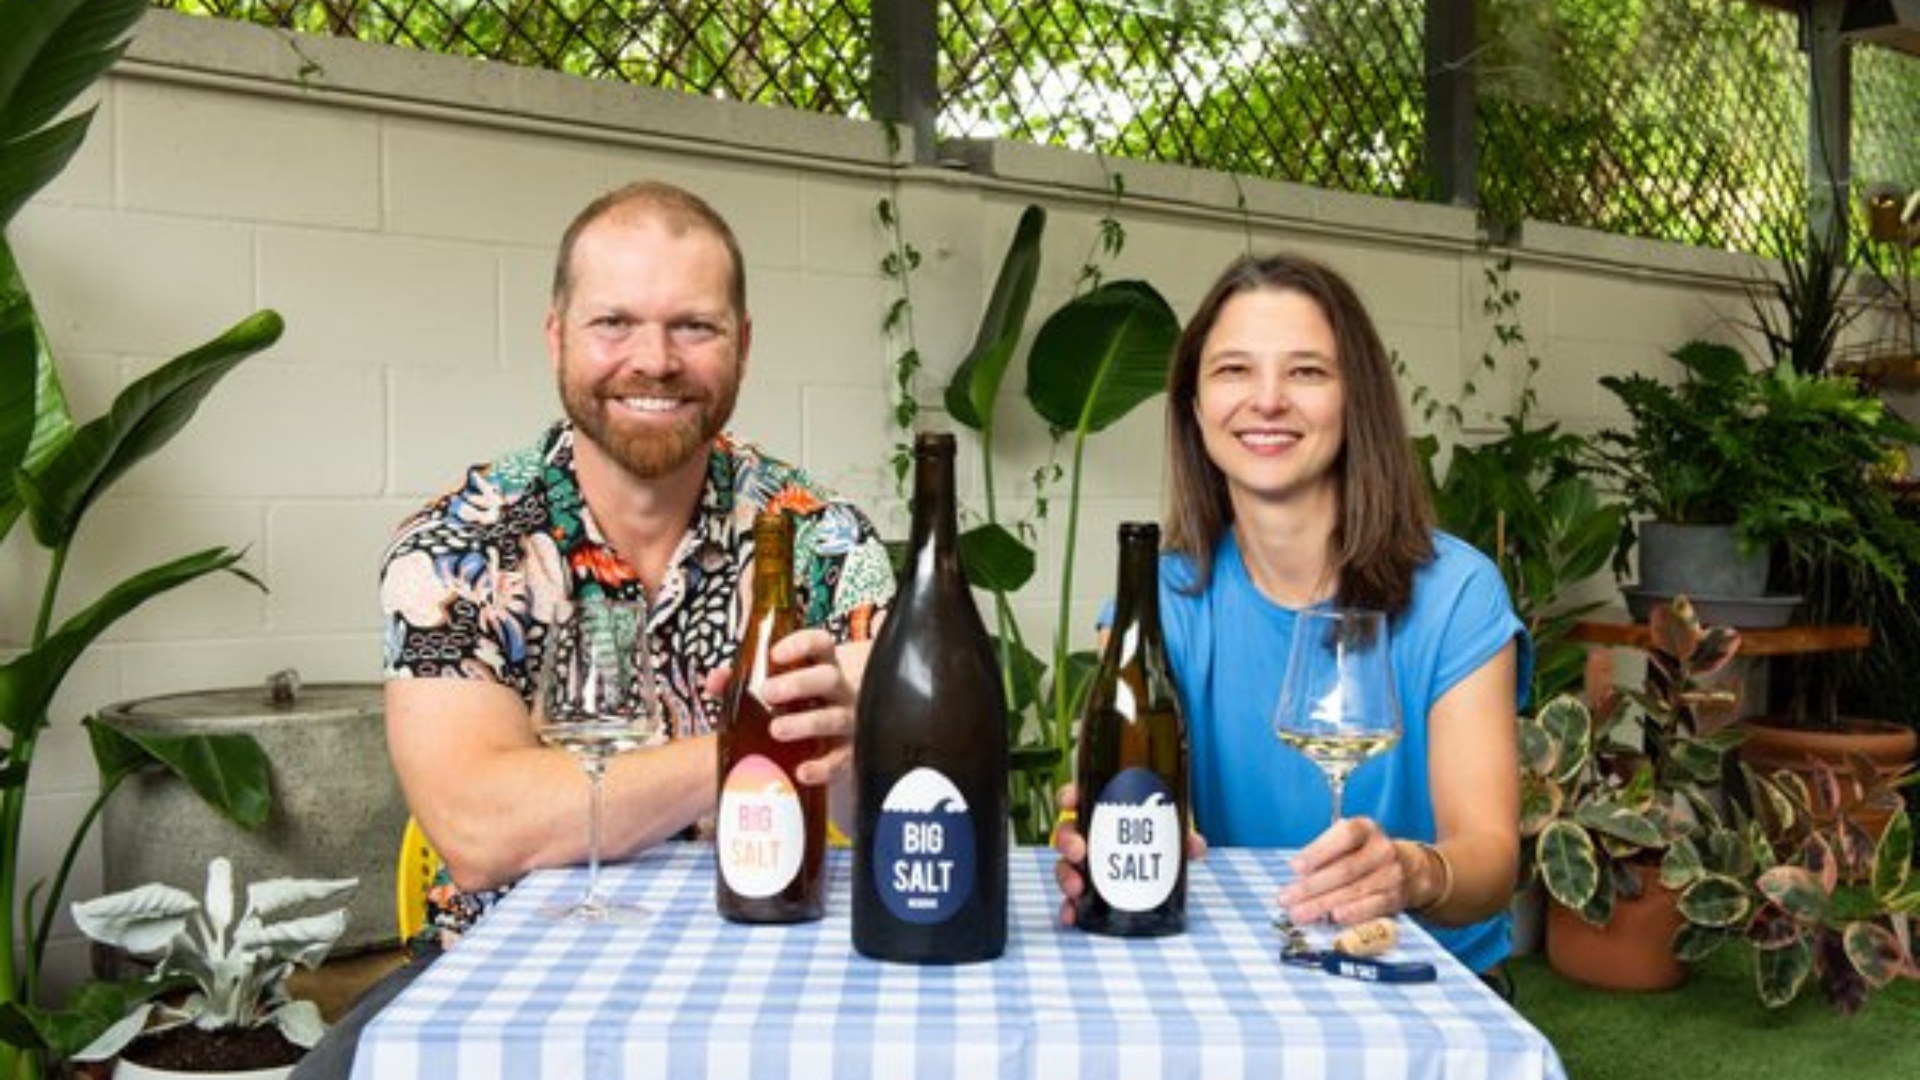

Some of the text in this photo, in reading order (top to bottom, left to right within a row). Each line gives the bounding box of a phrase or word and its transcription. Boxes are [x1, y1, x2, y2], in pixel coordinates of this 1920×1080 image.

[738, 805, 772, 831] BIG
[1118, 817, 1153, 845] BIG
[903, 821, 944, 854] BIG
[732, 838, 780, 869] SALT
[1108, 852, 1162, 881] SALT
[893, 859, 954, 892] SALT
